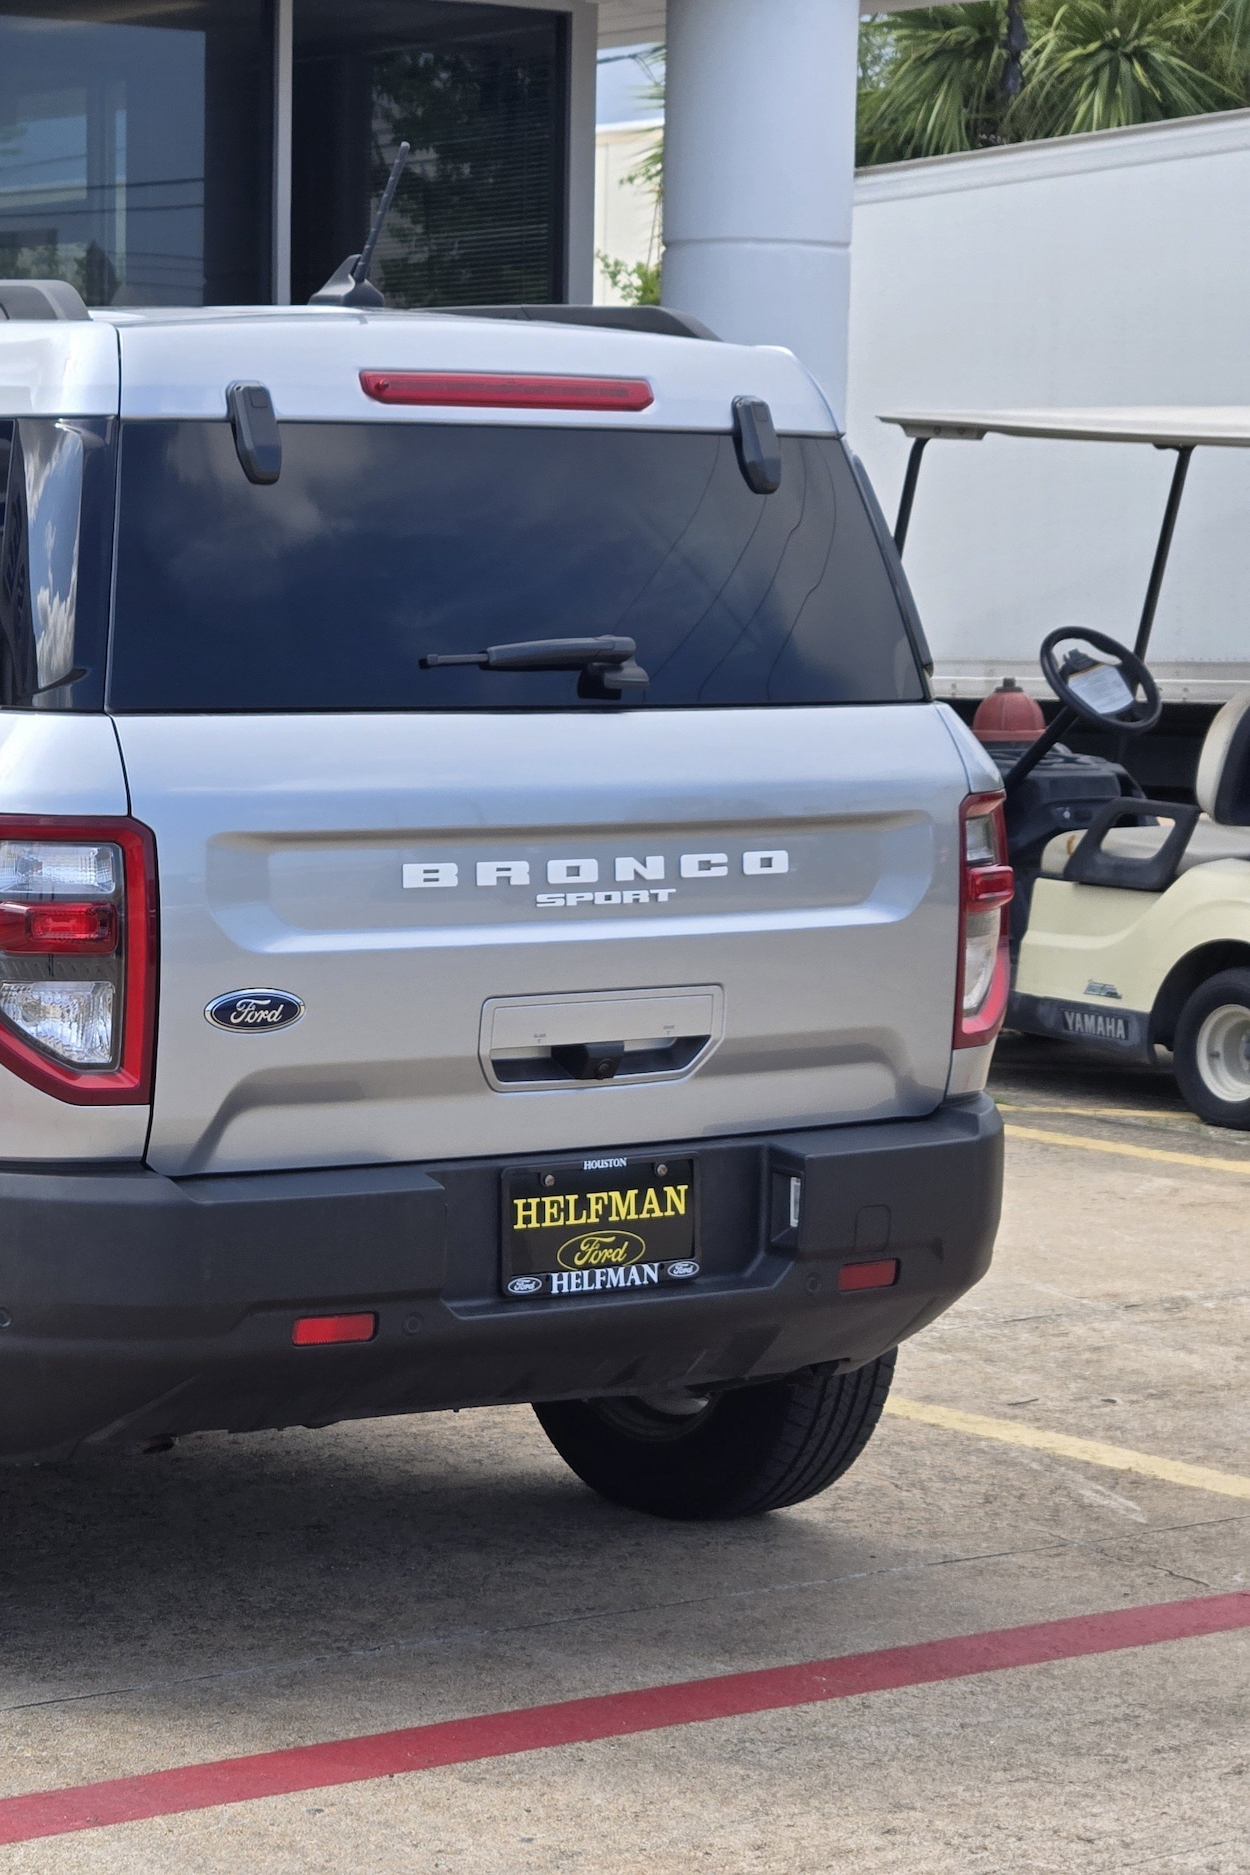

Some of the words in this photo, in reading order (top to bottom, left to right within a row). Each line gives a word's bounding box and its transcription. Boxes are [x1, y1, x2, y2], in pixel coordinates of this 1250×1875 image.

[402, 850, 789, 889] BRONCO
[535, 888, 677, 907] SPORT
[230, 998, 285, 1024] Ford
[1064, 1011, 1126, 1040] YAMAHA
[583, 1157, 628, 1170] HOUSTON
[513, 1184, 689, 1230] HELFMAN
[573, 1236, 629, 1266] Ford
[550, 1263, 660, 1294] HELFMAN
